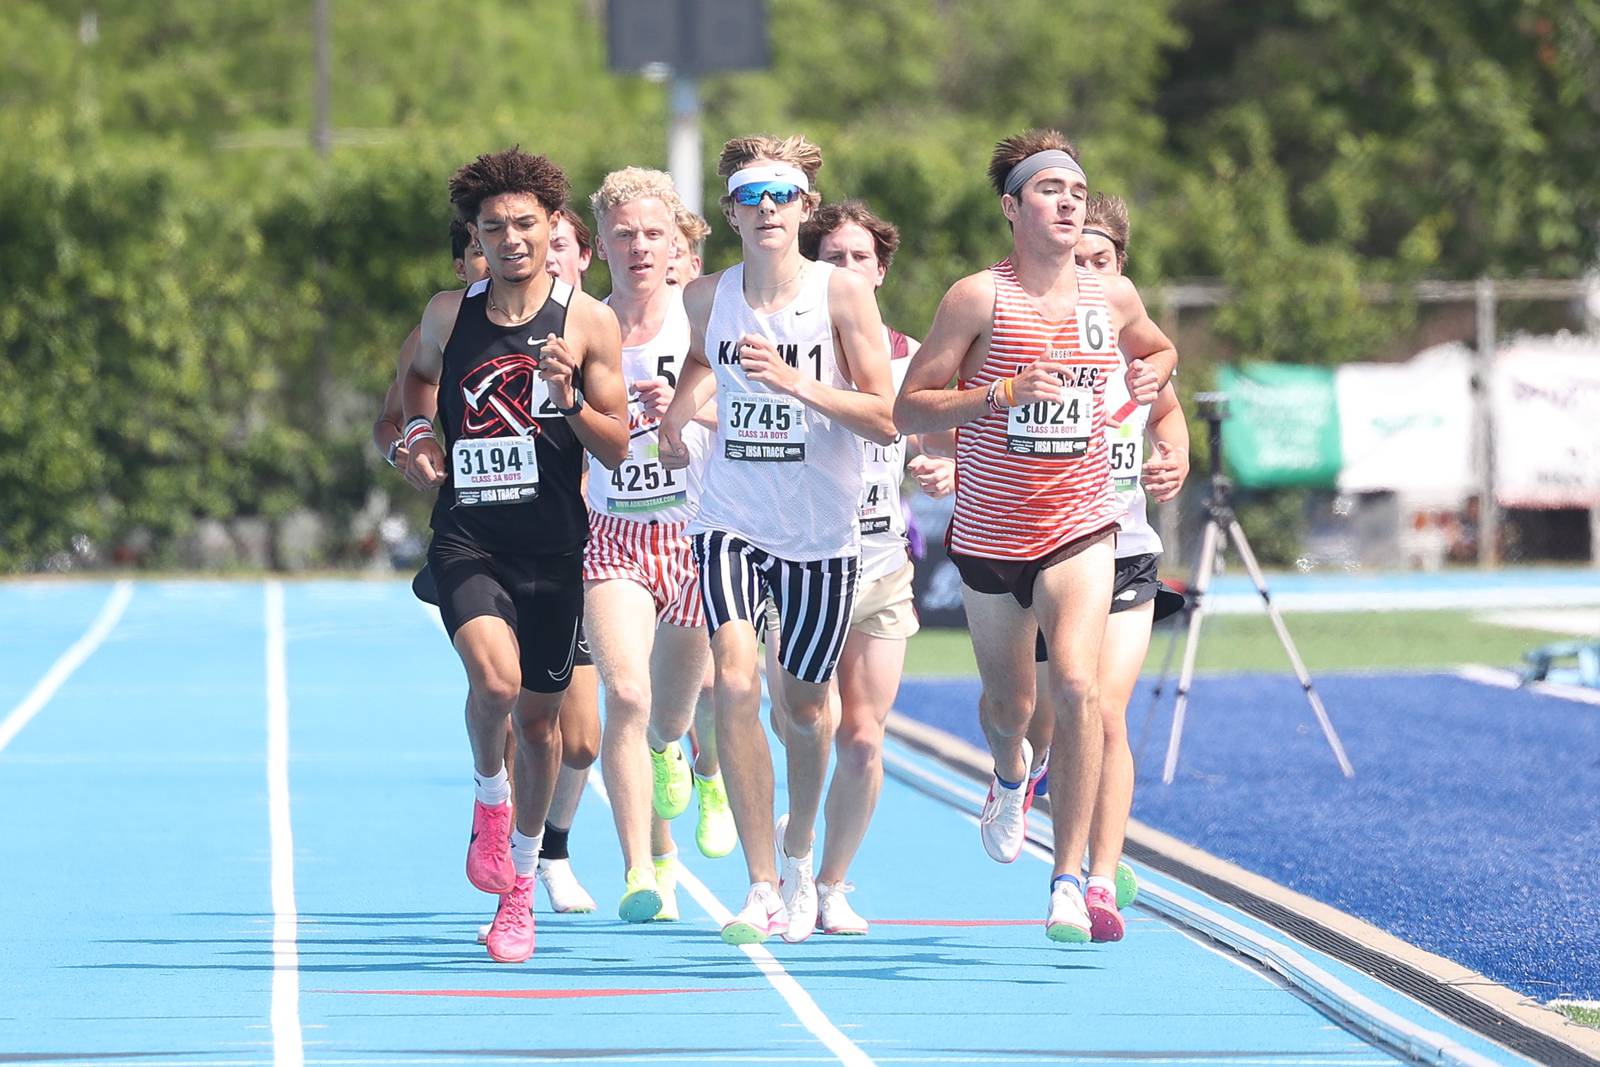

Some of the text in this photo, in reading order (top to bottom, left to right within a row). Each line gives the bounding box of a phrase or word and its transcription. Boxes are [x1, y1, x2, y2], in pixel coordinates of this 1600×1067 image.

[1085, 309, 1104, 351] 6
[808, 344, 822, 382] 1
[1050, 349, 1073, 359] ERSEY
[656, 355, 677, 390] 5
[730, 401, 791, 431] 3745
[1015, 398, 1081, 425] 3024
[738, 430, 789, 439] CLASS 3A BOYS
[1026, 424, 1078, 434] CLASS 3A BOYS
[762, 446, 785, 458] TRACK
[1052, 440, 1074, 453] TRACK
[1110, 442, 1137, 470] 53
[458, 446, 523, 475] 3194
[471, 472, 521, 484] CLASS 3A BOYS
[611, 462, 676, 492] 4251
[497, 487, 520, 501] TRACK
